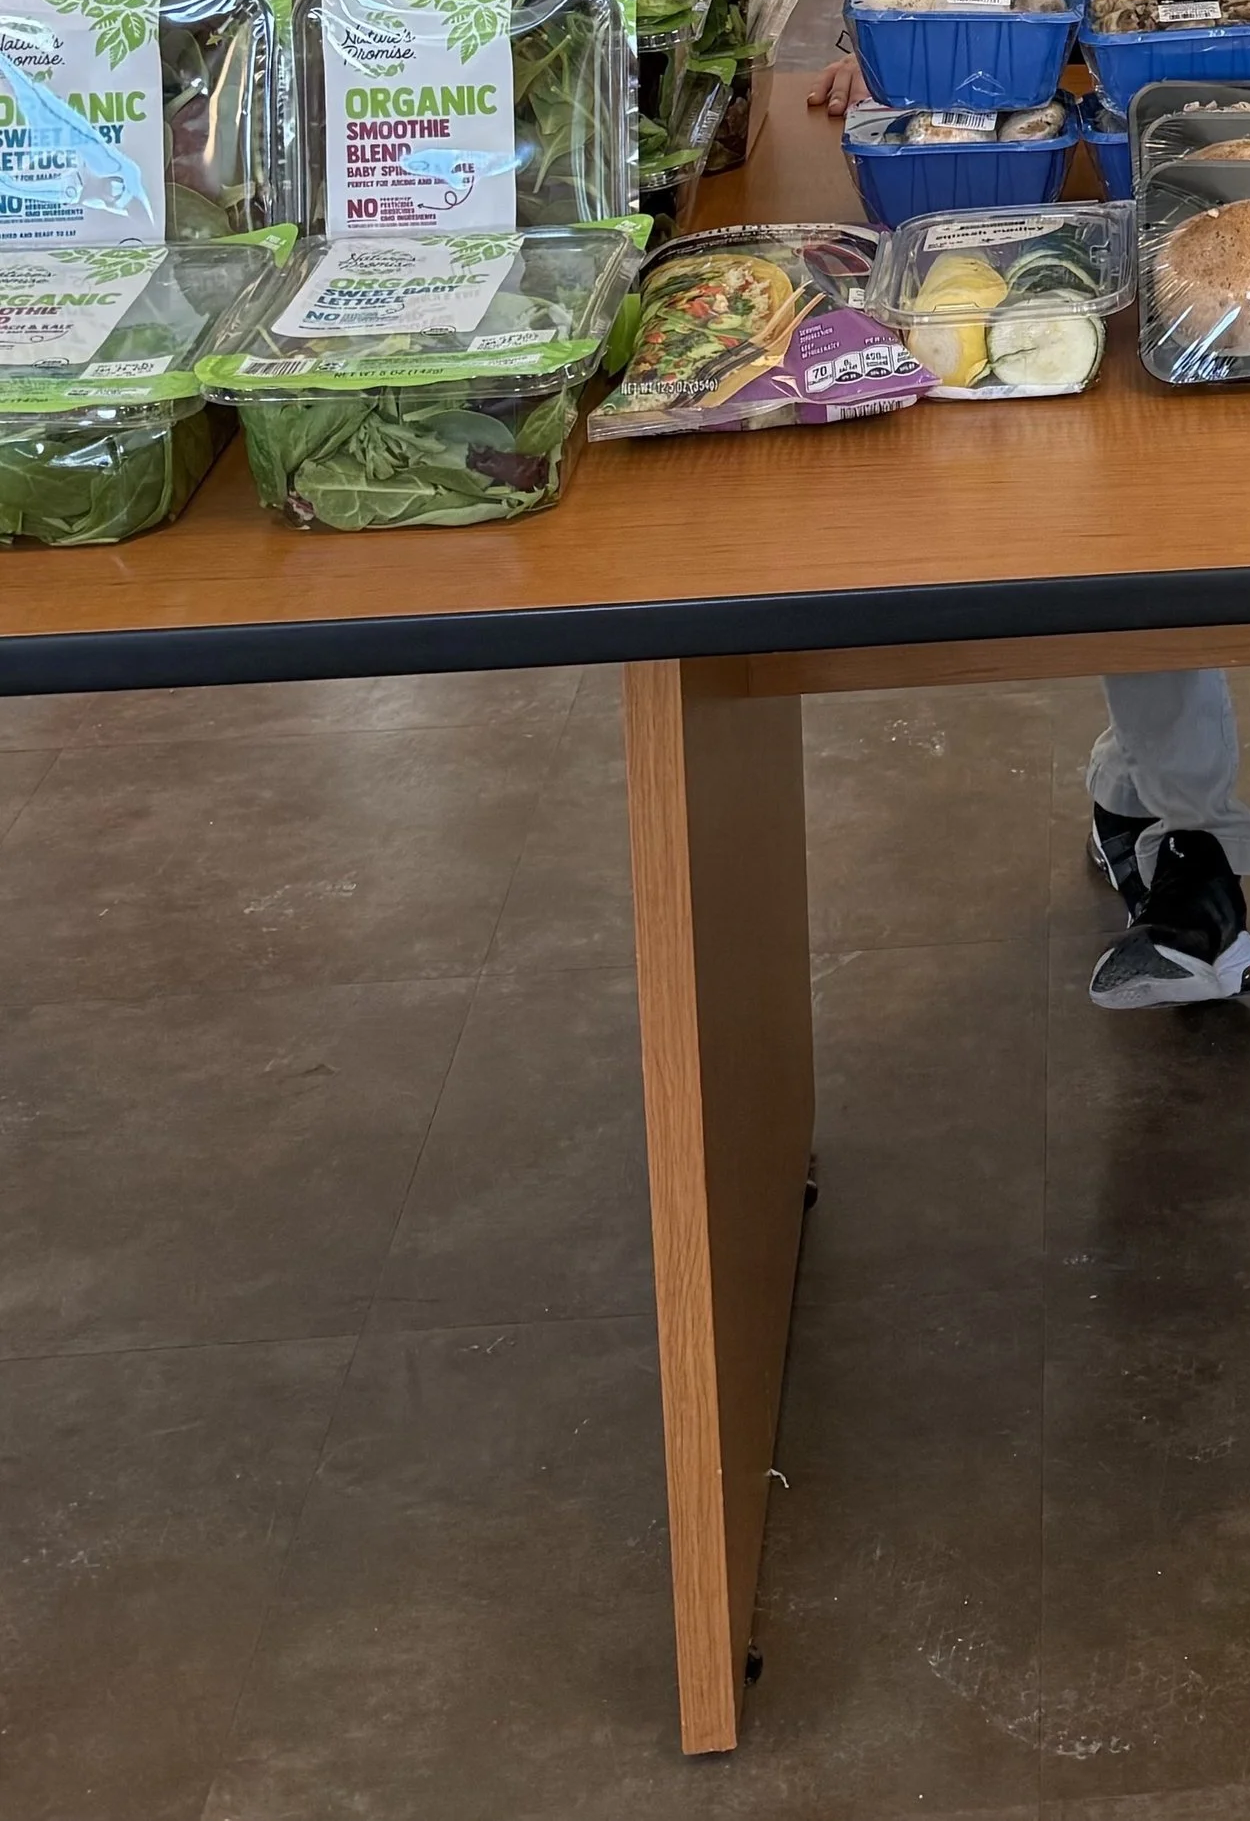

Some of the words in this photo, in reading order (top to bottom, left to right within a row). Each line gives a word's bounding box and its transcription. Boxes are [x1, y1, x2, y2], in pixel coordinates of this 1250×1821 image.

[0, 90, 147, 126] OANIC
[344, 84, 498, 119] ORGANIC
[0, 128, 61, 149] WEET
[71, 125, 124, 147] BBY
[346, 119, 450, 141] SMOOTHIE
[0, 149, 78, 172] ETTUCE
[346, 143, 412, 164] BLEND
[347, 166, 376, 178] BABY
[347, 198, 379, 219] NO
[329, 274, 490, 290] ORGANIC
[316, 295, 407, 306] LETTUCE
[323, 288, 399, 298] SWEET
[402, 285, 460, 296] BABY
[305, 310, 341, 321] NO
[812, 366, 828, 379] 70
[621, 382, 637, 395] NET
